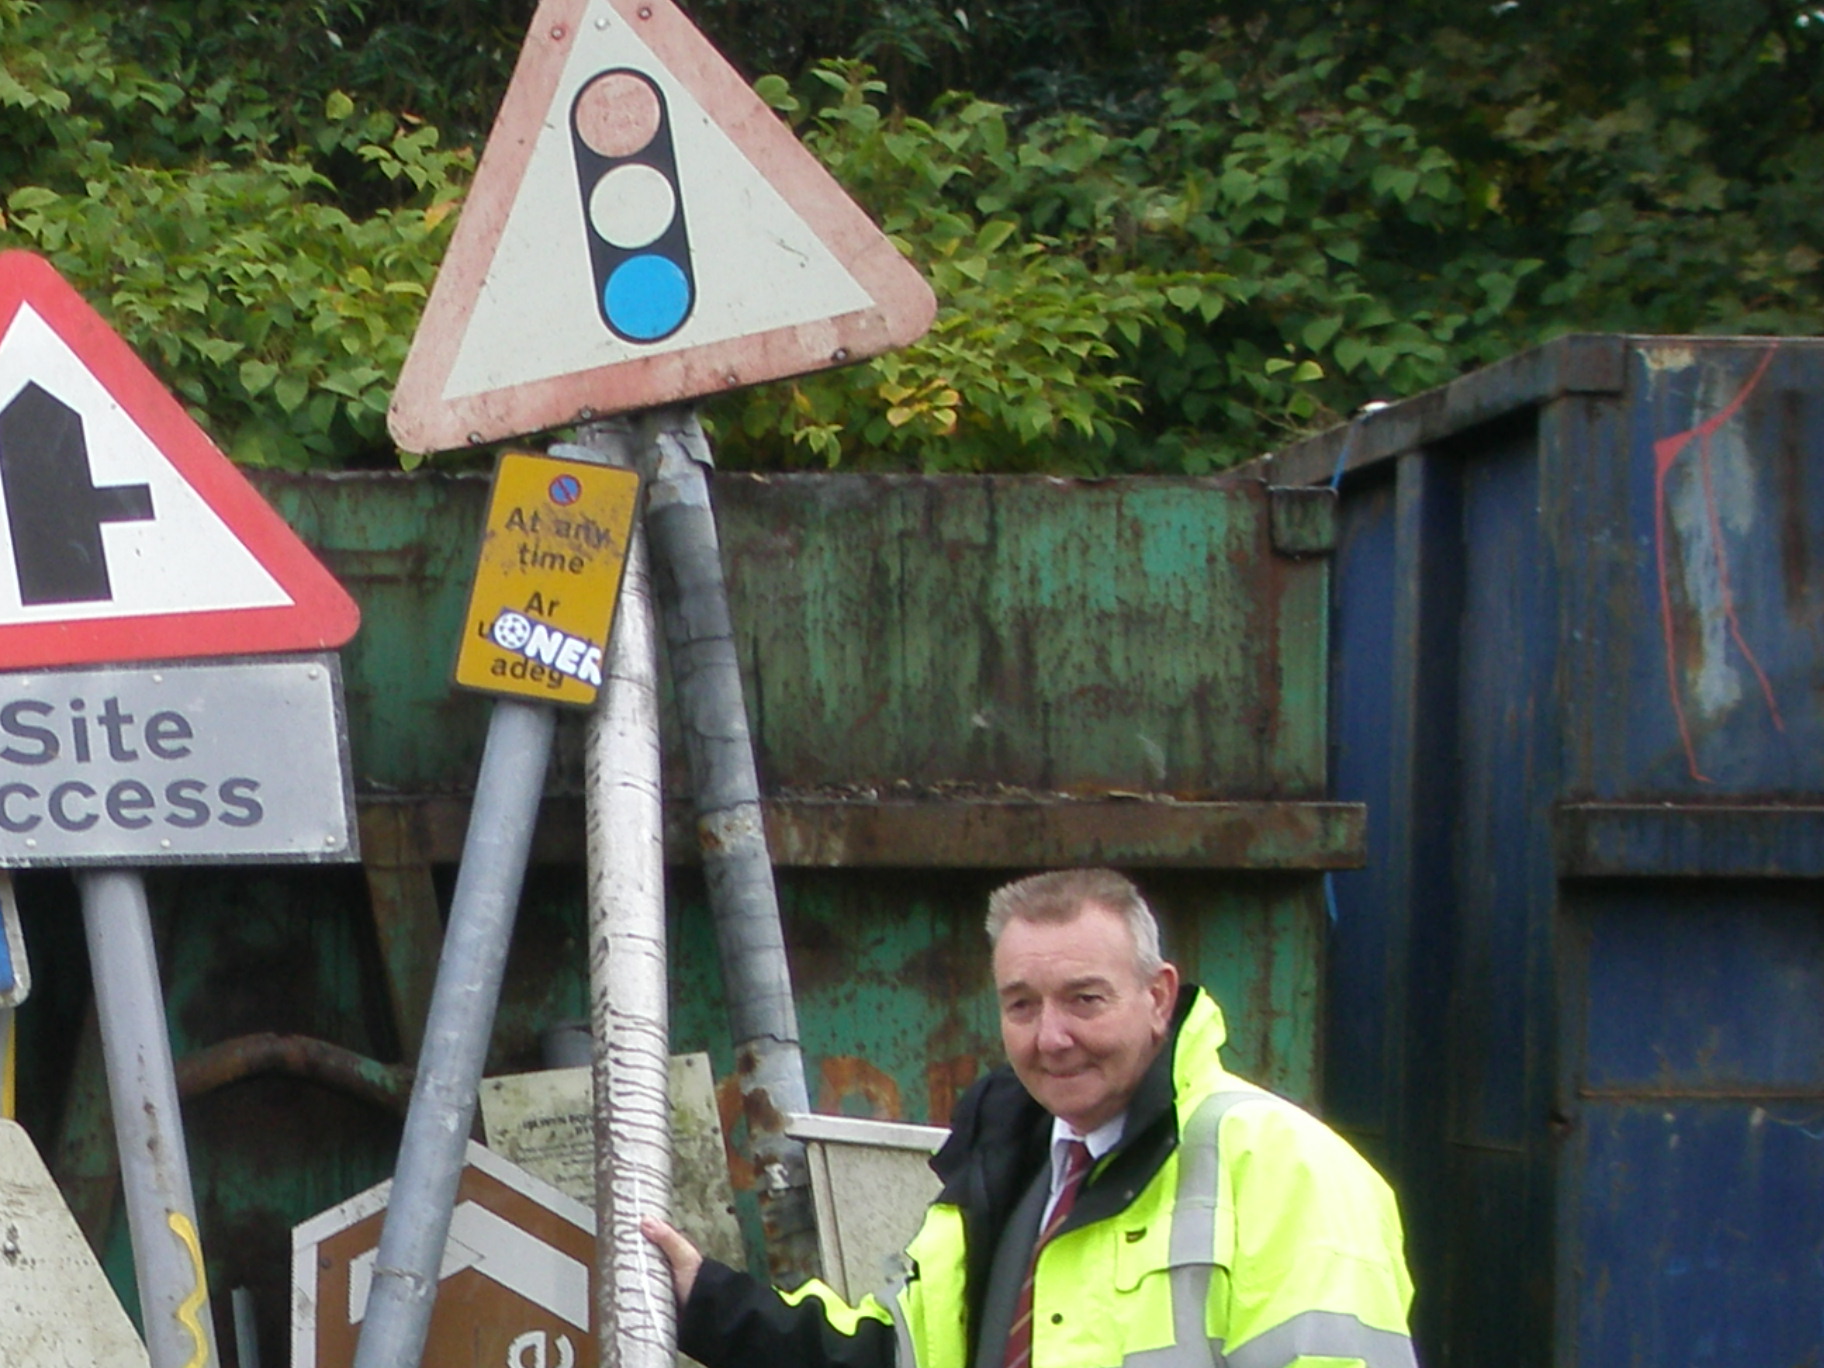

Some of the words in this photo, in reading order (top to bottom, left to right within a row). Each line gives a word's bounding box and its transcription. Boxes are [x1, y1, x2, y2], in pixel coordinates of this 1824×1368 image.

[504, 507, 541, 535] At
[518, 541, 585, 575] time
[523, 590, 561, 618] Ar
